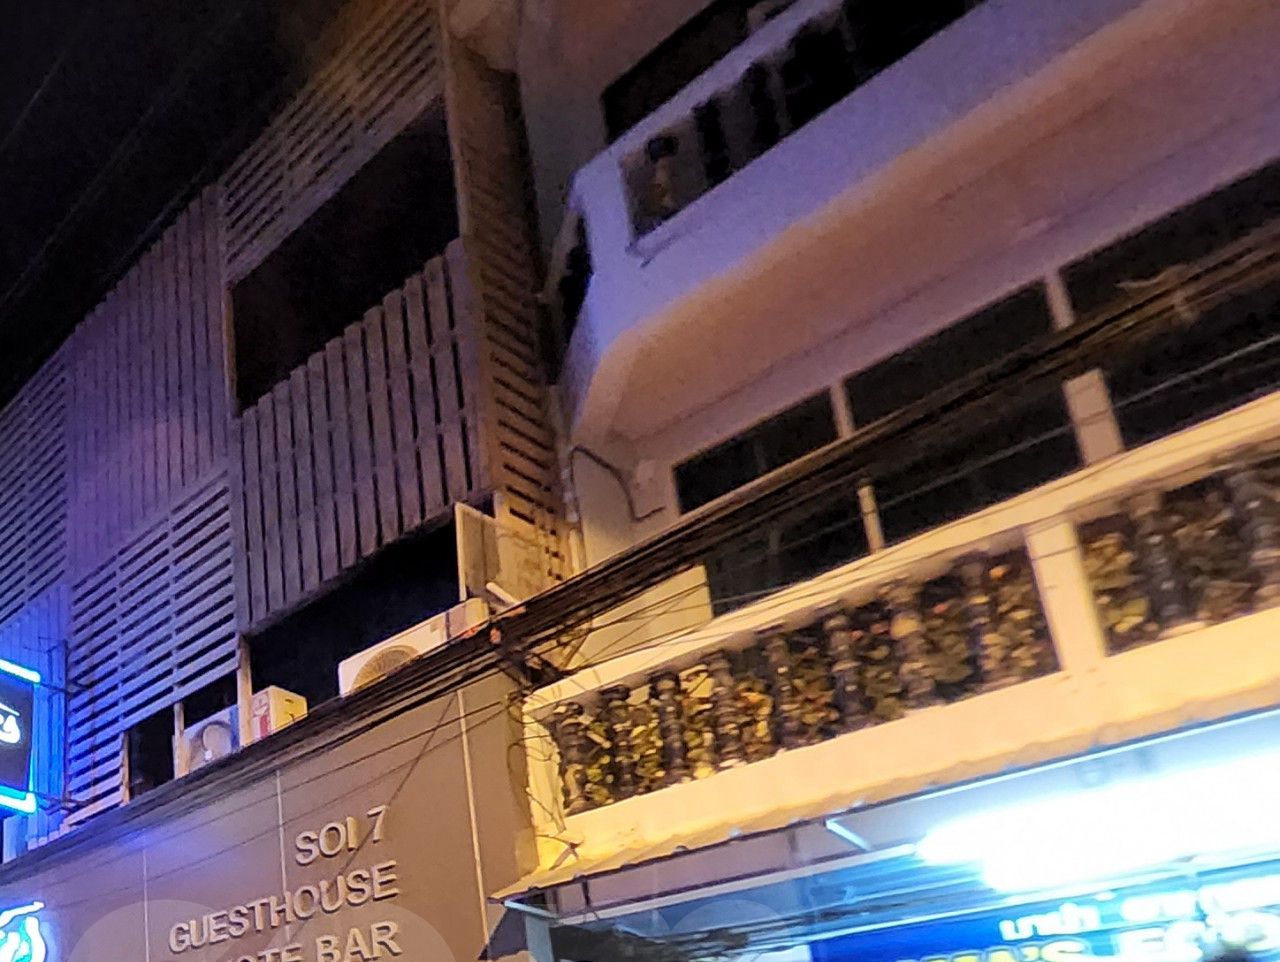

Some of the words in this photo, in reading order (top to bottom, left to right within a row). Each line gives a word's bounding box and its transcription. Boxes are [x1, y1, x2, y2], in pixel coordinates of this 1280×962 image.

[295, 816, 357, 866] SOI
[367, 804, 390, 844] 7
[169, 860, 400, 954] GUESTHOUSE
